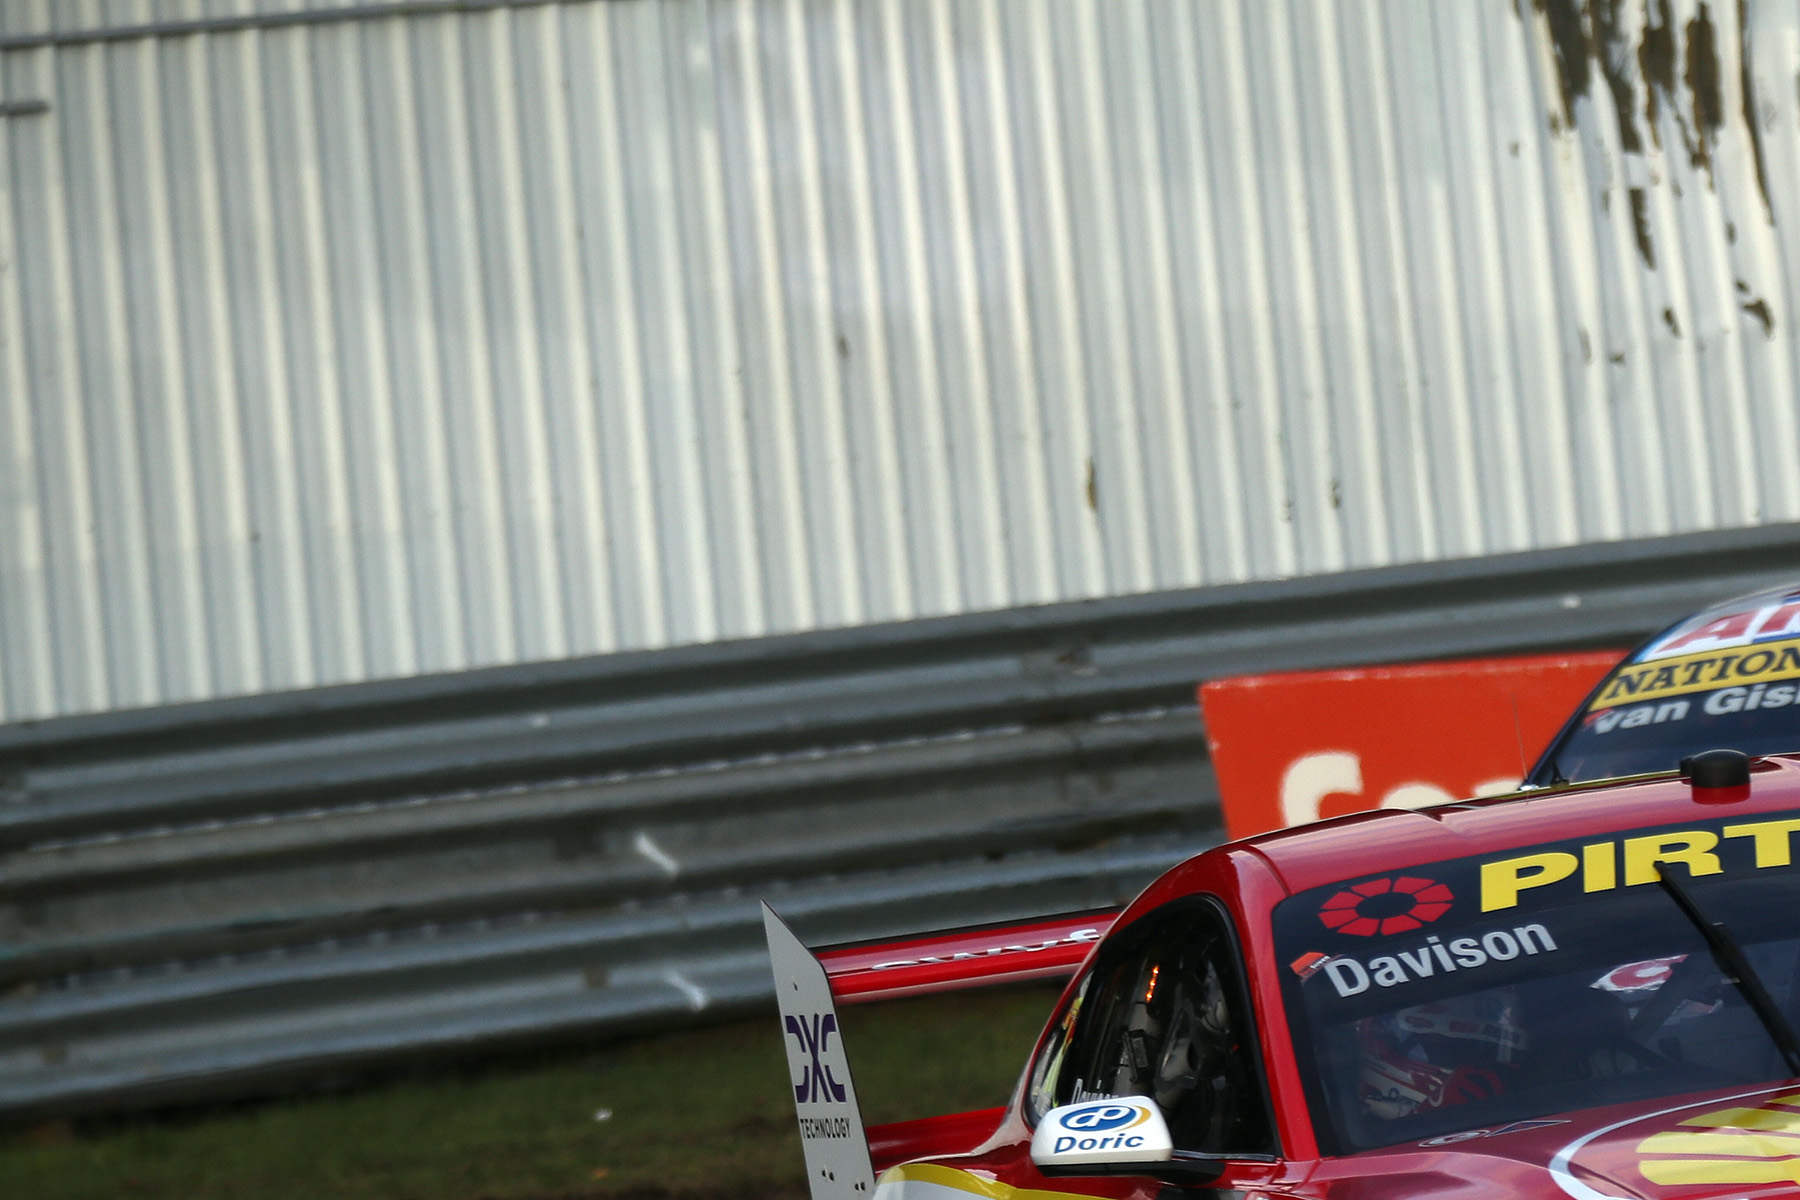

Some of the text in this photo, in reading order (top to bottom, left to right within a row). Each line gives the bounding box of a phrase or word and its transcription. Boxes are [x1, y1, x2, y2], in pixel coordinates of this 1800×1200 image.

[1594, 700, 1690, 734] van
[1324, 923, 1557, 998] Davison
[785, 1013, 847, 1103] DXC
[800, 1117, 851, 1139] TECHNOLOGY
[1054, 1133, 1145, 1154] Doric
